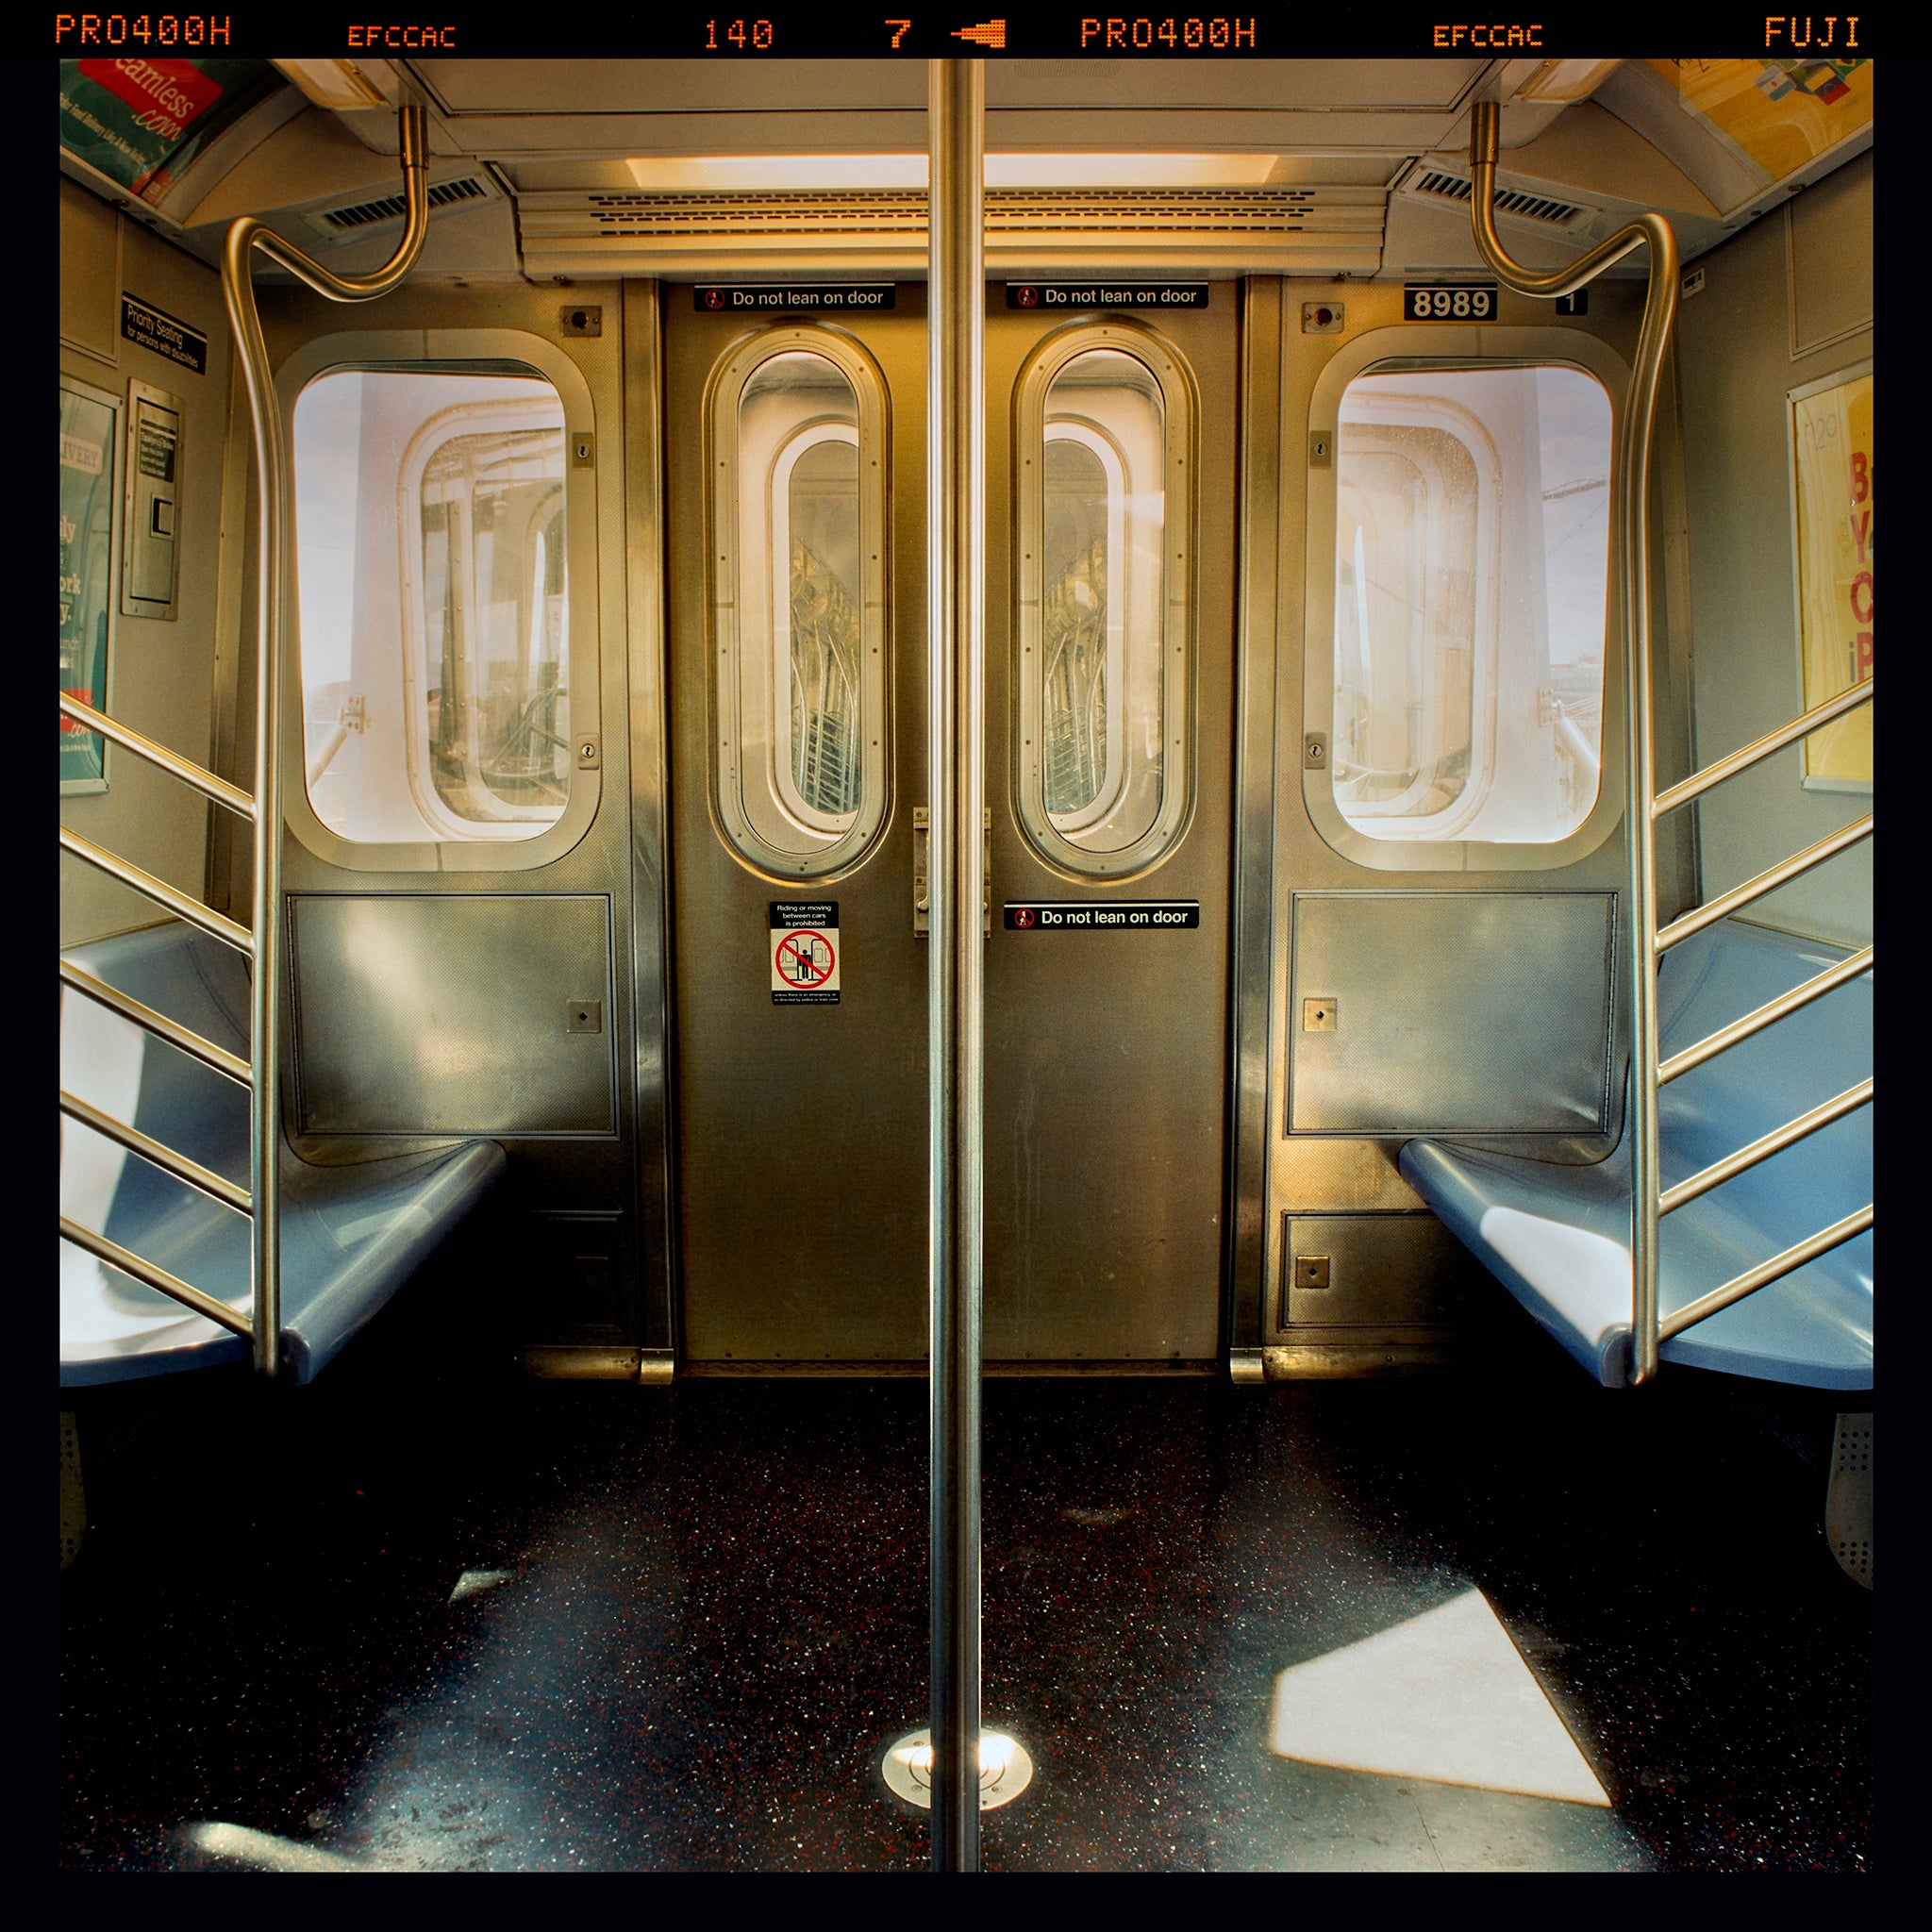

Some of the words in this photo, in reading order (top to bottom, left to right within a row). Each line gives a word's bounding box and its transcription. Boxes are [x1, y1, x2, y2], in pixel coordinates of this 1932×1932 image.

[108, 58, 194, 118] eamless
[733, 291, 754, 305] Do
[759, 291, 783, 305] not
[788, 291, 819, 304] lean
[824, 293, 843, 304] on
[848, 290, 884, 304] door
[1045, 290, 1067, 303] Do
[1072, 290, 1096, 303] not
[1101, 289, 1131, 302] lean
[1137, 291, 1157, 302] on
[1161, 289, 1197, 302] door
[1414, 291, 1490, 317] 8989
[1565, 292, 1575, 311] 1
[127, 303, 155, 336] Priority
[156, 319, 183, 350] Seating
[777, 905, 798, 913] Riding
[1041, 910, 1062, 924] Do
[1067, 910, 1091, 924] not
[1095, 910, 1125, 924] lean
[1130, 912, 1149, 924] on
[1153, 909, 1189, 924] door
